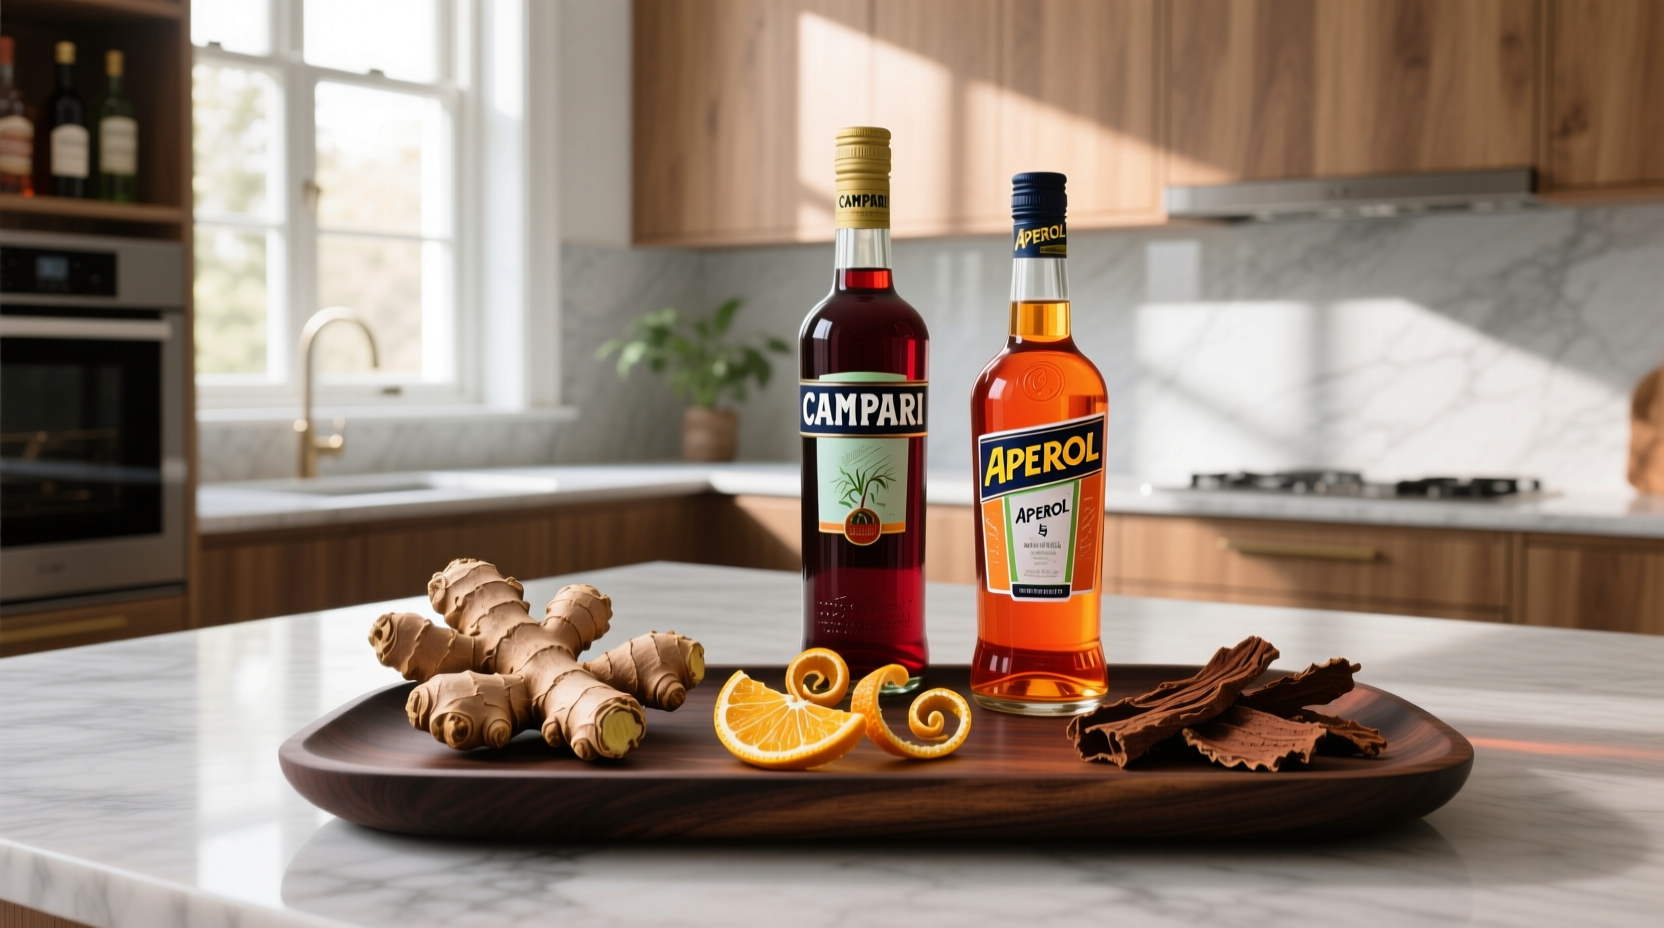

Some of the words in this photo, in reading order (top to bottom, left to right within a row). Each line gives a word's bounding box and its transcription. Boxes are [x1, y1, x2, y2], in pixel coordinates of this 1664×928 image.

[1014, 224, 1066, 251] APEROL
[802, 392, 923, 426] CAMPARI
[984, 432, 1099, 487] APEROL
[1015, 499, 1070, 524] APEROL
